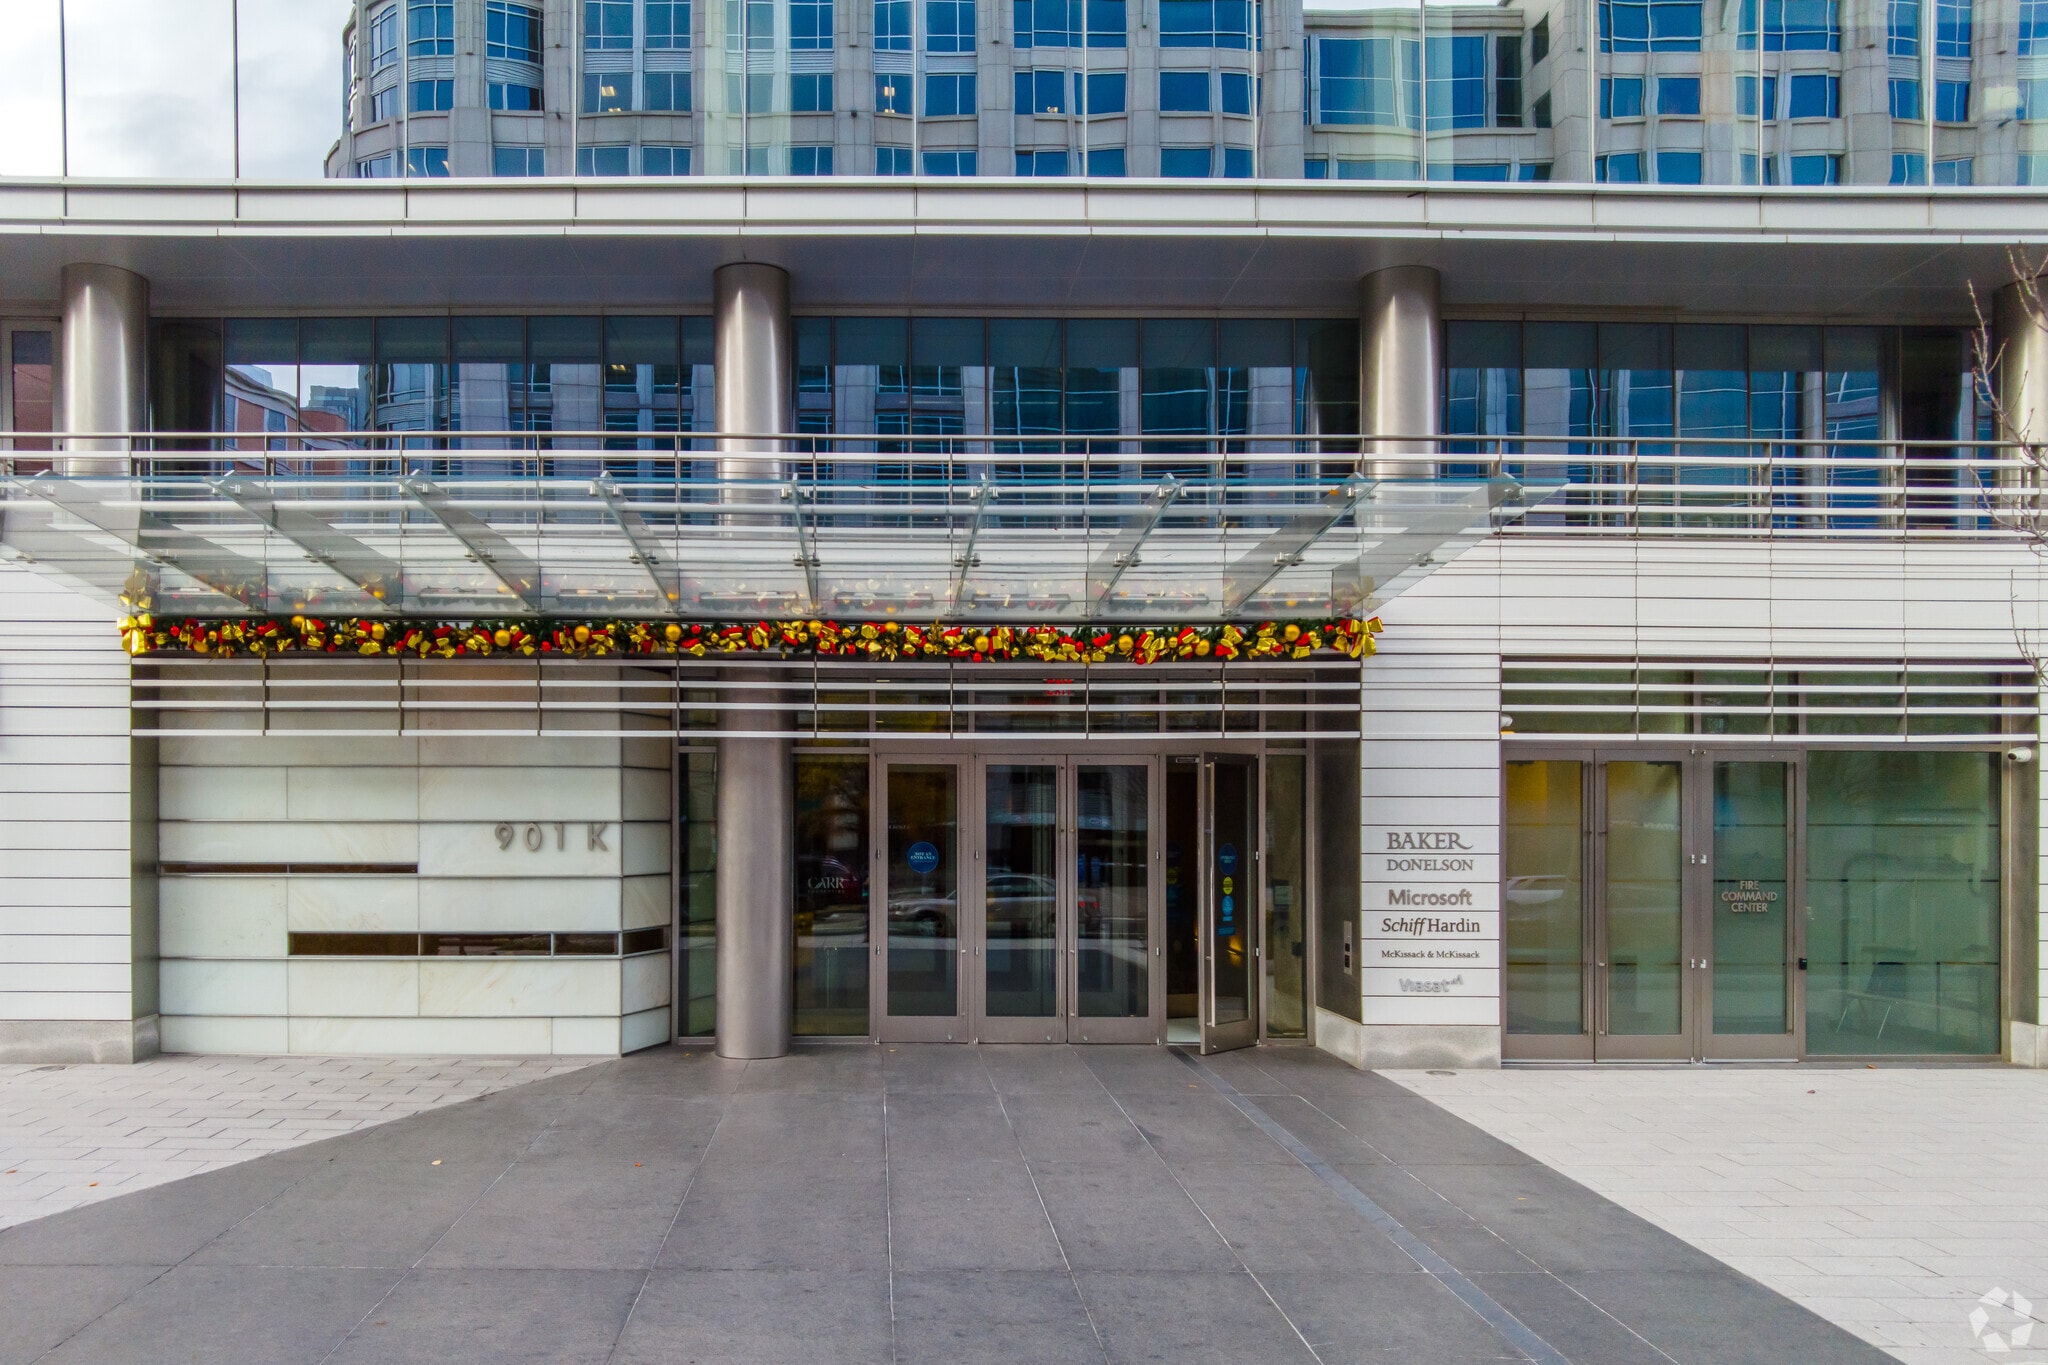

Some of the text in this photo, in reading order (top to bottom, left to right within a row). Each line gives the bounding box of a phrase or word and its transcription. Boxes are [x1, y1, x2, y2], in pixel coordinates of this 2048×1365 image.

[1387, 832, 1474, 850] BAKER
[1386, 859, 1474, 872] DONELSON
[808, 876, 845, 889] CARR
[1740, 880, 1759, 890] FIRE
[1388, 889, 1472, 905] Microsoft
[1721, 891, 1778, 902] COMMAND
[1731, 902, 1768, 912] CENTER
[1381, 918, 1481, 936] Schiff Hardin
[1381, 950, 1481, 959] McKissack & McKissack
